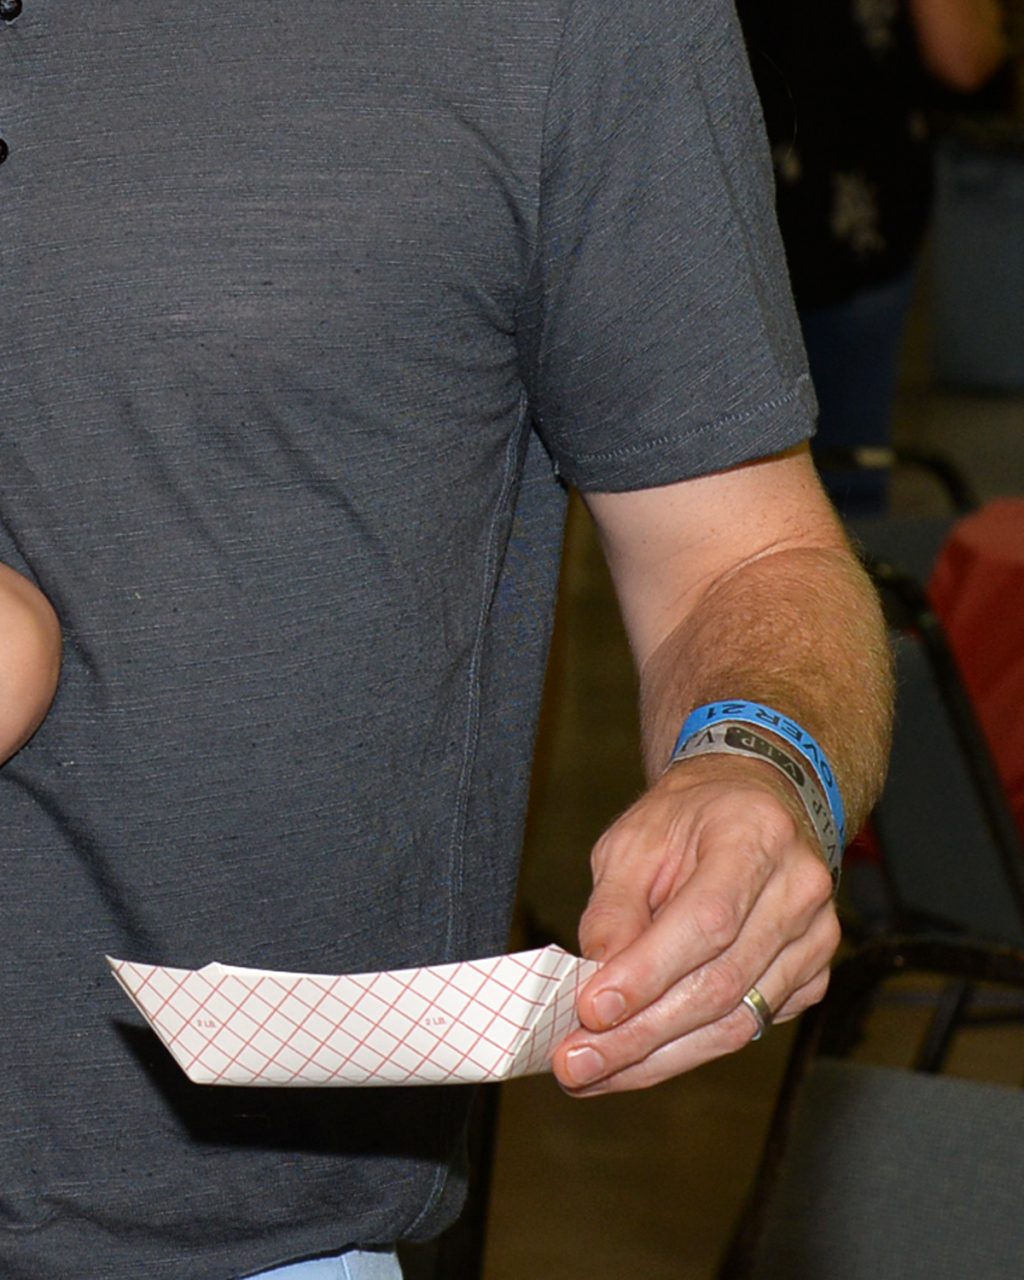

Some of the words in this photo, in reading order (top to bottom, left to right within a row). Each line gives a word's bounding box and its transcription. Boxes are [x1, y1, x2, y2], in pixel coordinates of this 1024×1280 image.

[707, 703, 746, 720] 21
[735, 729, 798, 778] V.I.P.
[755, 708, 833, 787] OVER
